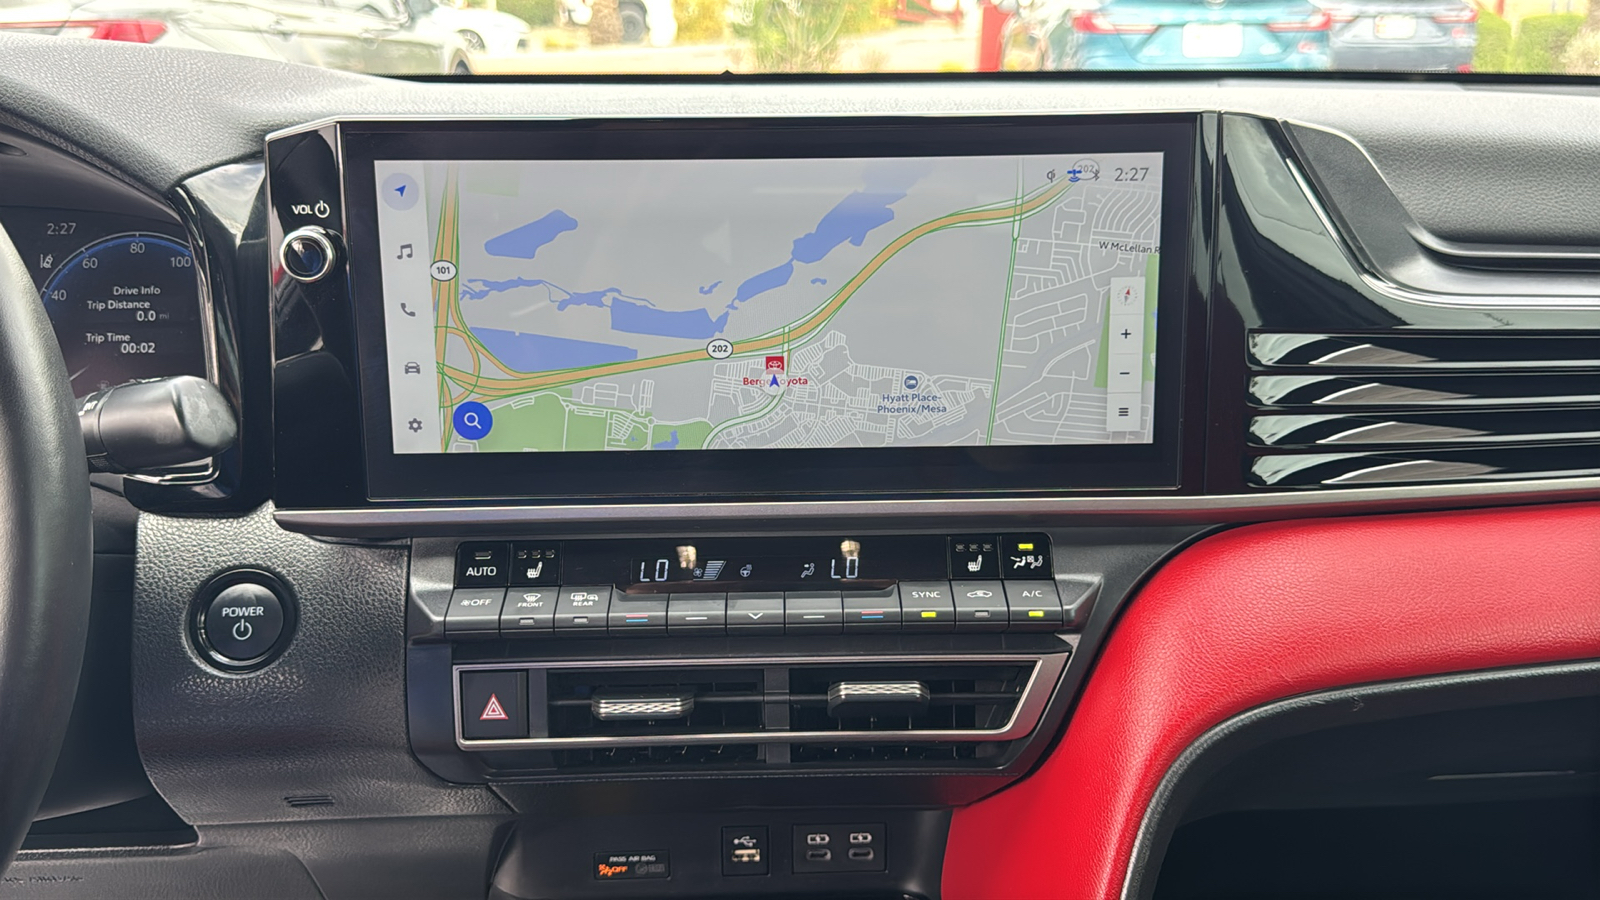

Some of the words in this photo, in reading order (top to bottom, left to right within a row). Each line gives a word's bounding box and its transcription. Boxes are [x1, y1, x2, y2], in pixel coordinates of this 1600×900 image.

[1114, 167, 1149, 182] 2:27
[291, 204, 313, 215] VOL
[47, 222, 77, 236] 2:27
[130, 243, 145, 254] 80
[1099, 241, 1109, 250] W
[1111, 243, 1152, 254] McLellan
[82, 257, 98, 270] 60
[170, 256, 192, 269] 100
[436, 266, 450, 275] 101
[51, 289, 67, 301] 40
[113, 285, 138, 296] Drive
[141, 285, 161, 296] Info
[87, 300, 105, 311] Trip
[108, 300, 150, 310] Distance
[136, 310, 156, 322] 0.0
[86, 333, 105, 344] Trip
[108, 332, 130, 342] Time
[120, 343, 155, 354] 00:02
[711, 344, 728, 354] 202
[777, 376, 808, 387] oyota
[882, 393, 909, 404] Hyatt
[911, 392, 942, 402] Place-
[877, 404, 947, 414] Phoenix/Mesa
[466, 565, 497, 577] AUTO
[639, 559, 669, 581] LO
[830, 556, 859, 579] LO
[911, 589, 941, 599] SYNC
[1021, 588, 1043, 598] A/C
[471, 597, 492, 607] OFF
[517, 600, 543, 608] FRONT
[573, 599, 594, 607] REAR
[222, 606, 264, 617] POWER
[612, 865, 628, 874] OFF
